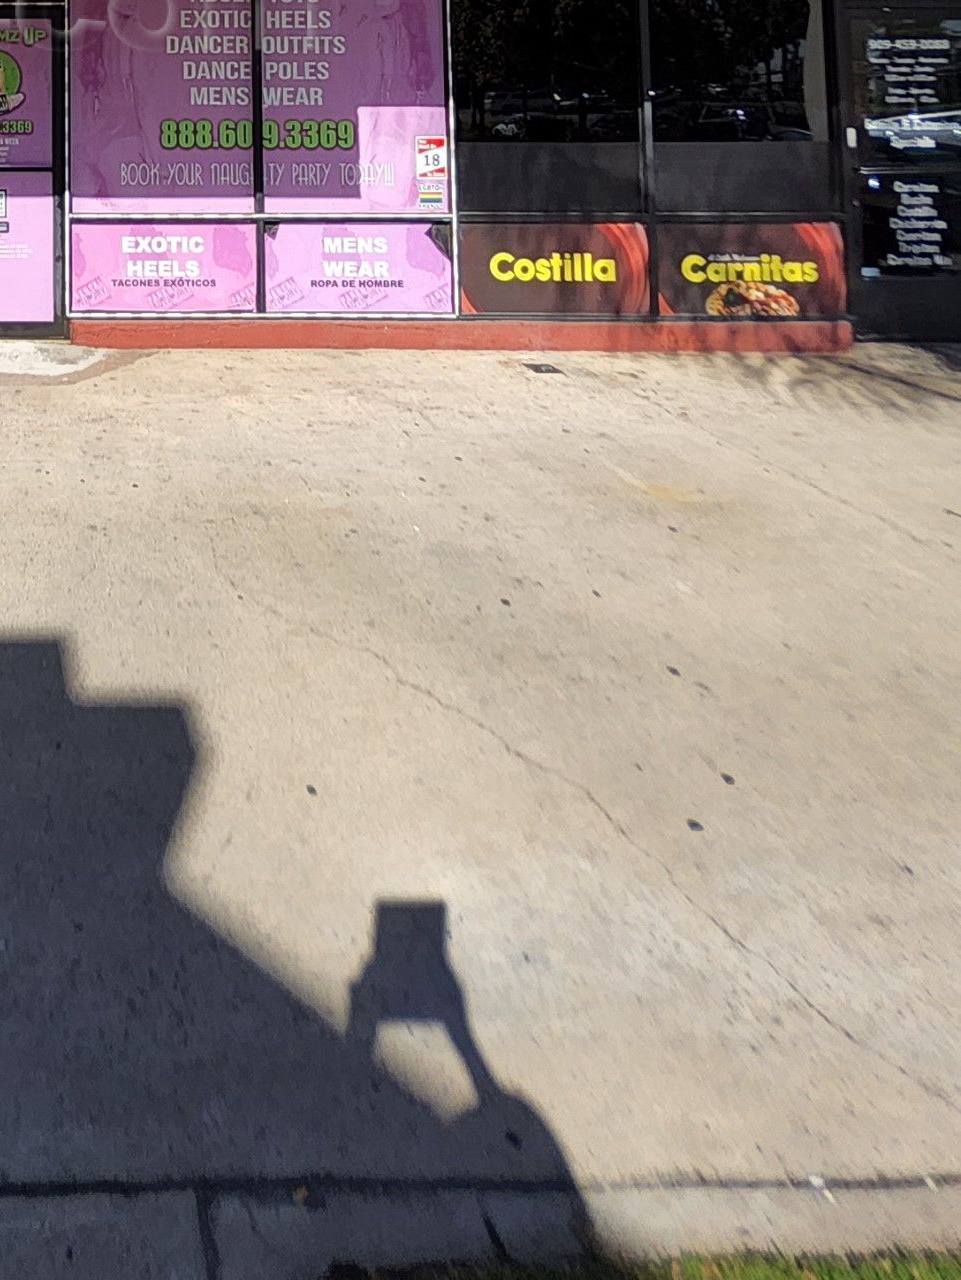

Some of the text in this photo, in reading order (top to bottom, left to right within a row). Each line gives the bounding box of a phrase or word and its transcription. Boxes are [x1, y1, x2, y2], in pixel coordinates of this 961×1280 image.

[180, 10, 332, 29] EXOTIC HEELS
[166, 36, 346, 54] DANCER OUTFITS
[183, 61, 330, 80] DANCE POLES
[190, 87, 324, 106] MENS WEAR
[160, 119, 355, 149] 888.609.3369
[424, 153, 440, 167] 18
[120, 163, 160, 186] BOOK
[167, 163, 204, 186] YOUR
[292, 163, 332, 186] PARTY
[120, 236, 206, 254] EXOTIC
[323, 236, 389, 254] MENS
[126, 260, 201, 278] HEELS
[322, 260, 390, 278] WEAR
[489, 251, 617, 282] Costilla
[681, 253, 819, 283] Carnitas
[110, 277, 217, 288] TACONES EXÓTICOS
[310, 279, 405, 288] ROPA DE HOMBRE
